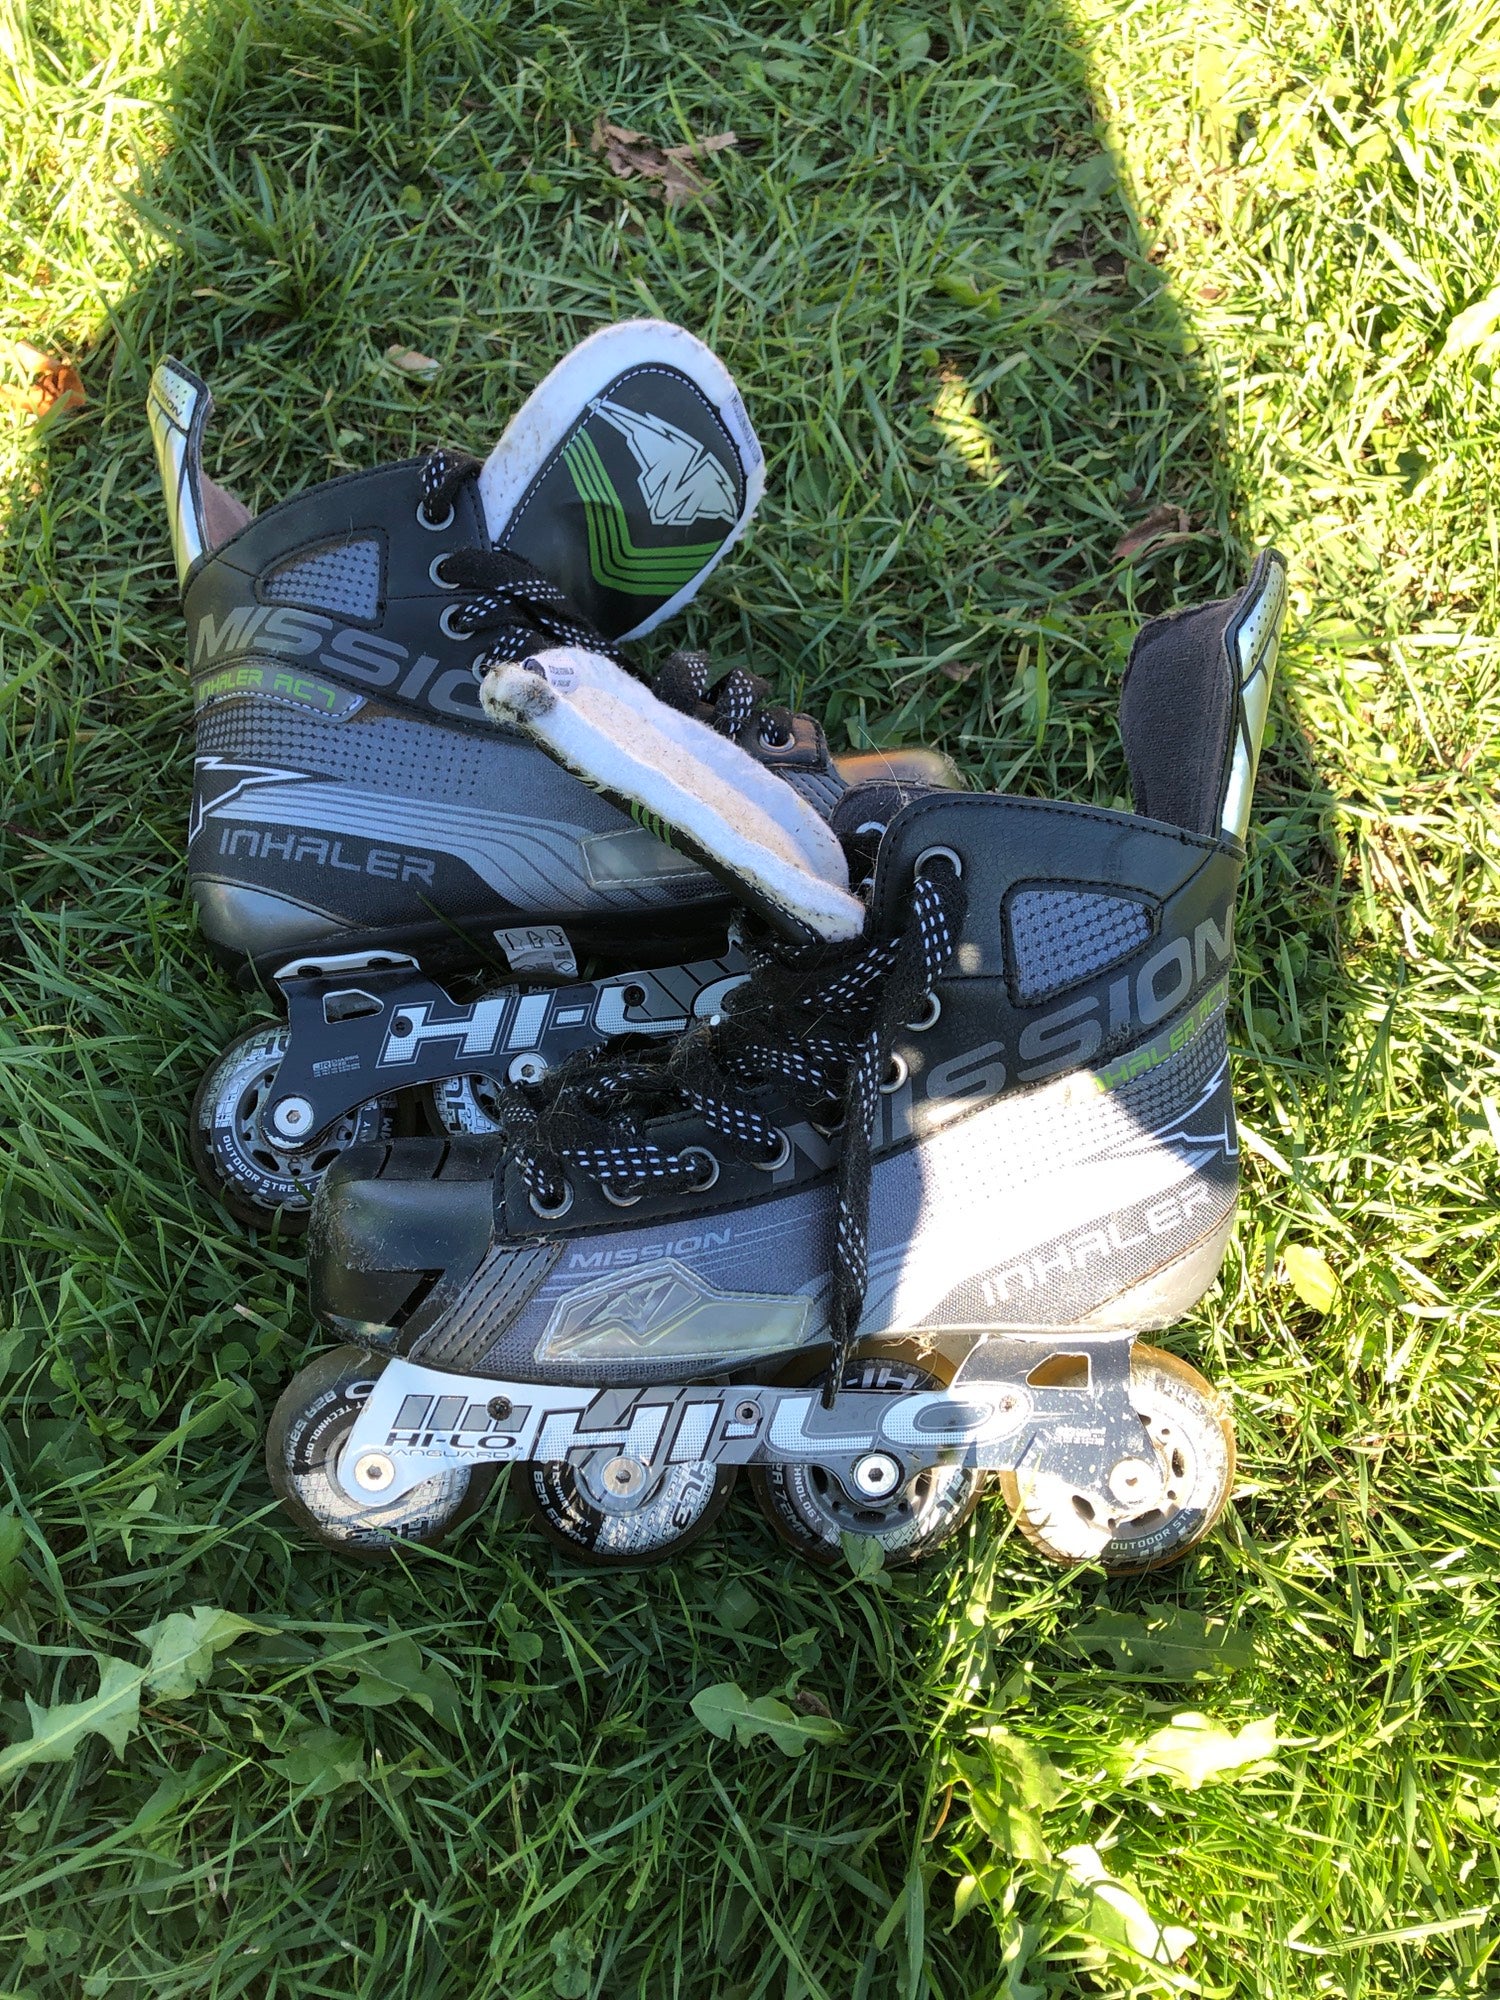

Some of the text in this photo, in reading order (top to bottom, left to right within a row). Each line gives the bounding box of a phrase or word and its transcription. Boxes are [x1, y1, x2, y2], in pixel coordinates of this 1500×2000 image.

[219, 828, 436, 888] INHALER
[1093, 1016, 1196, 1093] NHALER
[223, 1135, 260, 1183] OUTDOOR
[569, 1228, 731, 1268] MISSION
[982, 1181, 1209, 1307] INHALER
[304, 1405, 352, 1465] TECHNOLOGY
[381, 1449, 510, 1459] VANGUARD
[384, 1432, 517, 1449] HI-LO
[532, 1383, 1034, 1466] HI-LO
[794, 1463, 822, 1523] HNOLOGY
[1110, 1507, 1194, 1550] OUTDOOR STR
